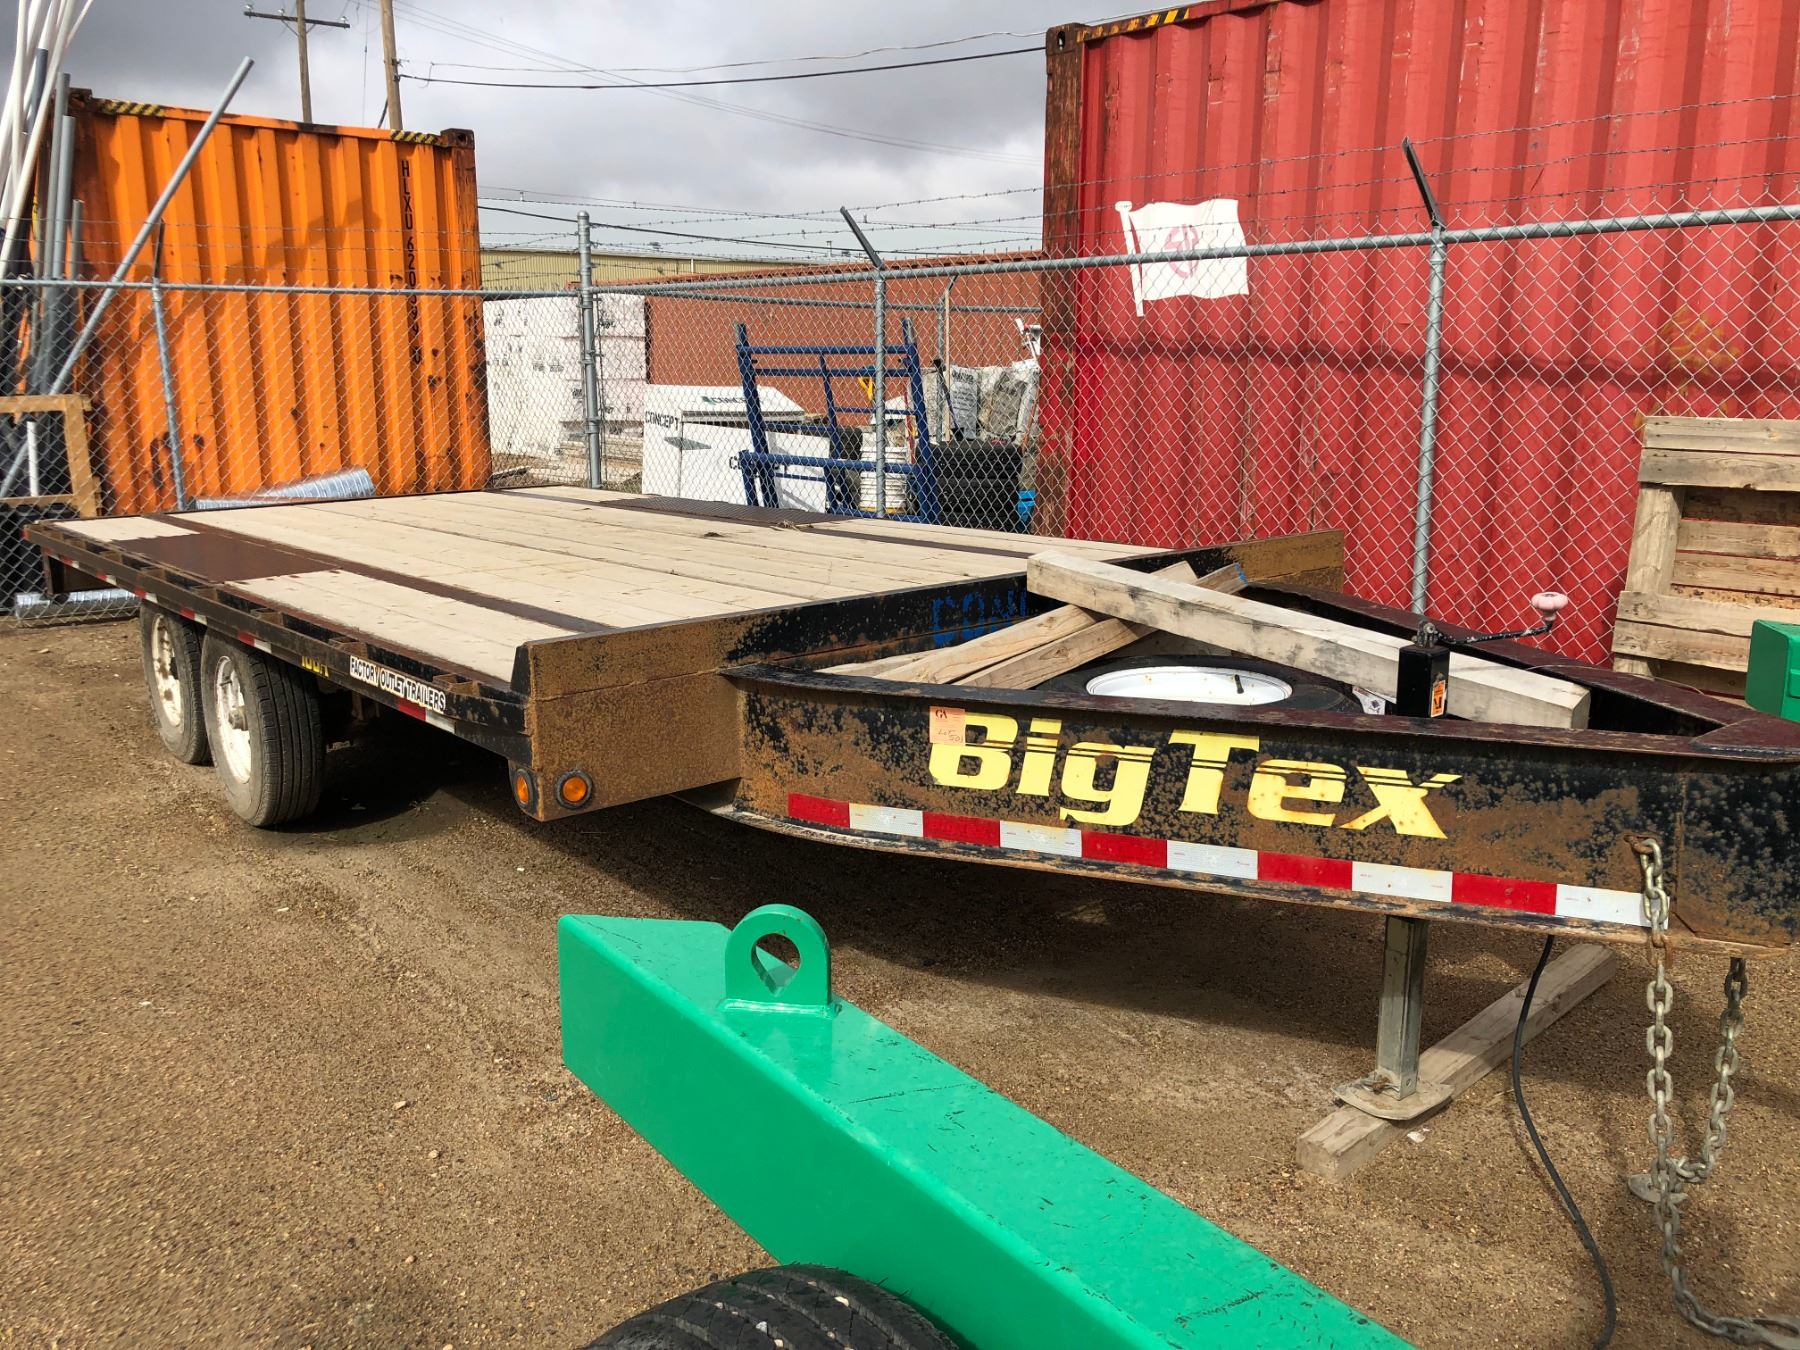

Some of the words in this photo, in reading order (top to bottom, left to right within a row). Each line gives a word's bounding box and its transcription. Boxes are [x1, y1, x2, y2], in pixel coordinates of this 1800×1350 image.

[401, 160, 413, 230] HLXU
[644, 411, 680, 431] CONCEPT
[350, 656, 379, 687] FACTORY
[380, 667, 405, 697] OUTLET
[406, 679, 446, 713] TRAILERS
